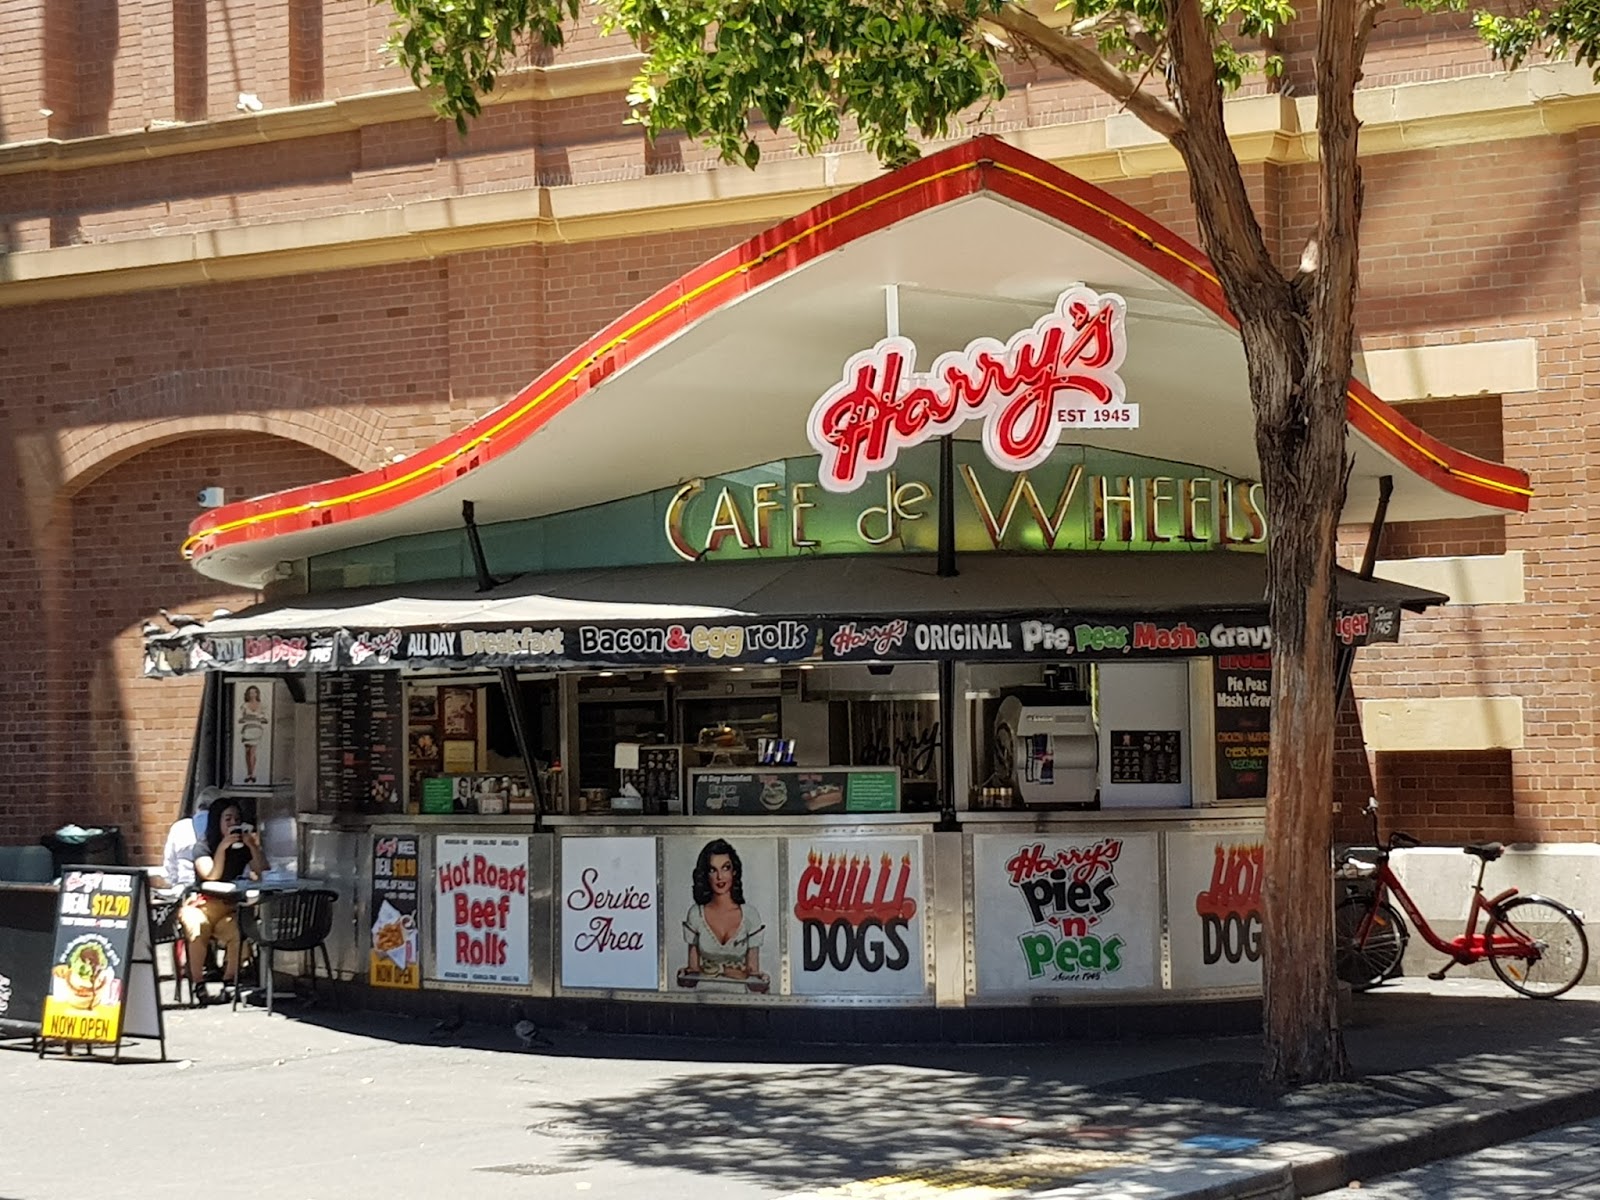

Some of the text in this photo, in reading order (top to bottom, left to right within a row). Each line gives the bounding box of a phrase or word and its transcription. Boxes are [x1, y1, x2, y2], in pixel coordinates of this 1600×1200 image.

[821, 300, 1116, 482] Harry's
[1057, 408, 1131, 423] EST 1945
[664, 463, 1268, 561] CAFE de WHEELS
[407, 634, 429, 656] ALL
[430, 632, 457, 656] DAY
[459, 627, 565, 657] Breakfast
[579, 621, 807, 659] Bacon & egg rolls
[830, 618, 908, 656] Harry's
[914, 622, 1012, 651] ORIGINAL
[1132, 621, 1197, 650] Mash
[1335, 610, 1369, 645] iger
[1216, 692, 1243, 707] Mash
[1250, 692, 1271, 707] Grav
[439, 853, 471, 894] Hot
[473, 852, 527, 896] Roast
[1006, 838, 1123, 885] Harry's
[91, 893, 132, 918] $12.90
[567, 867, 652, 911] Service
[1020, 867, 1117, 924] pies
[454, 891, 511, 931] Beef
[455, 930, 509, 967] Rolls
[574, 916, 645, 953] Area
[802, 916, 910, 973] DOGS
[1202, 910, 1263, 965] DOG
[51, 1015, 111, 1039] NOW OPEN
